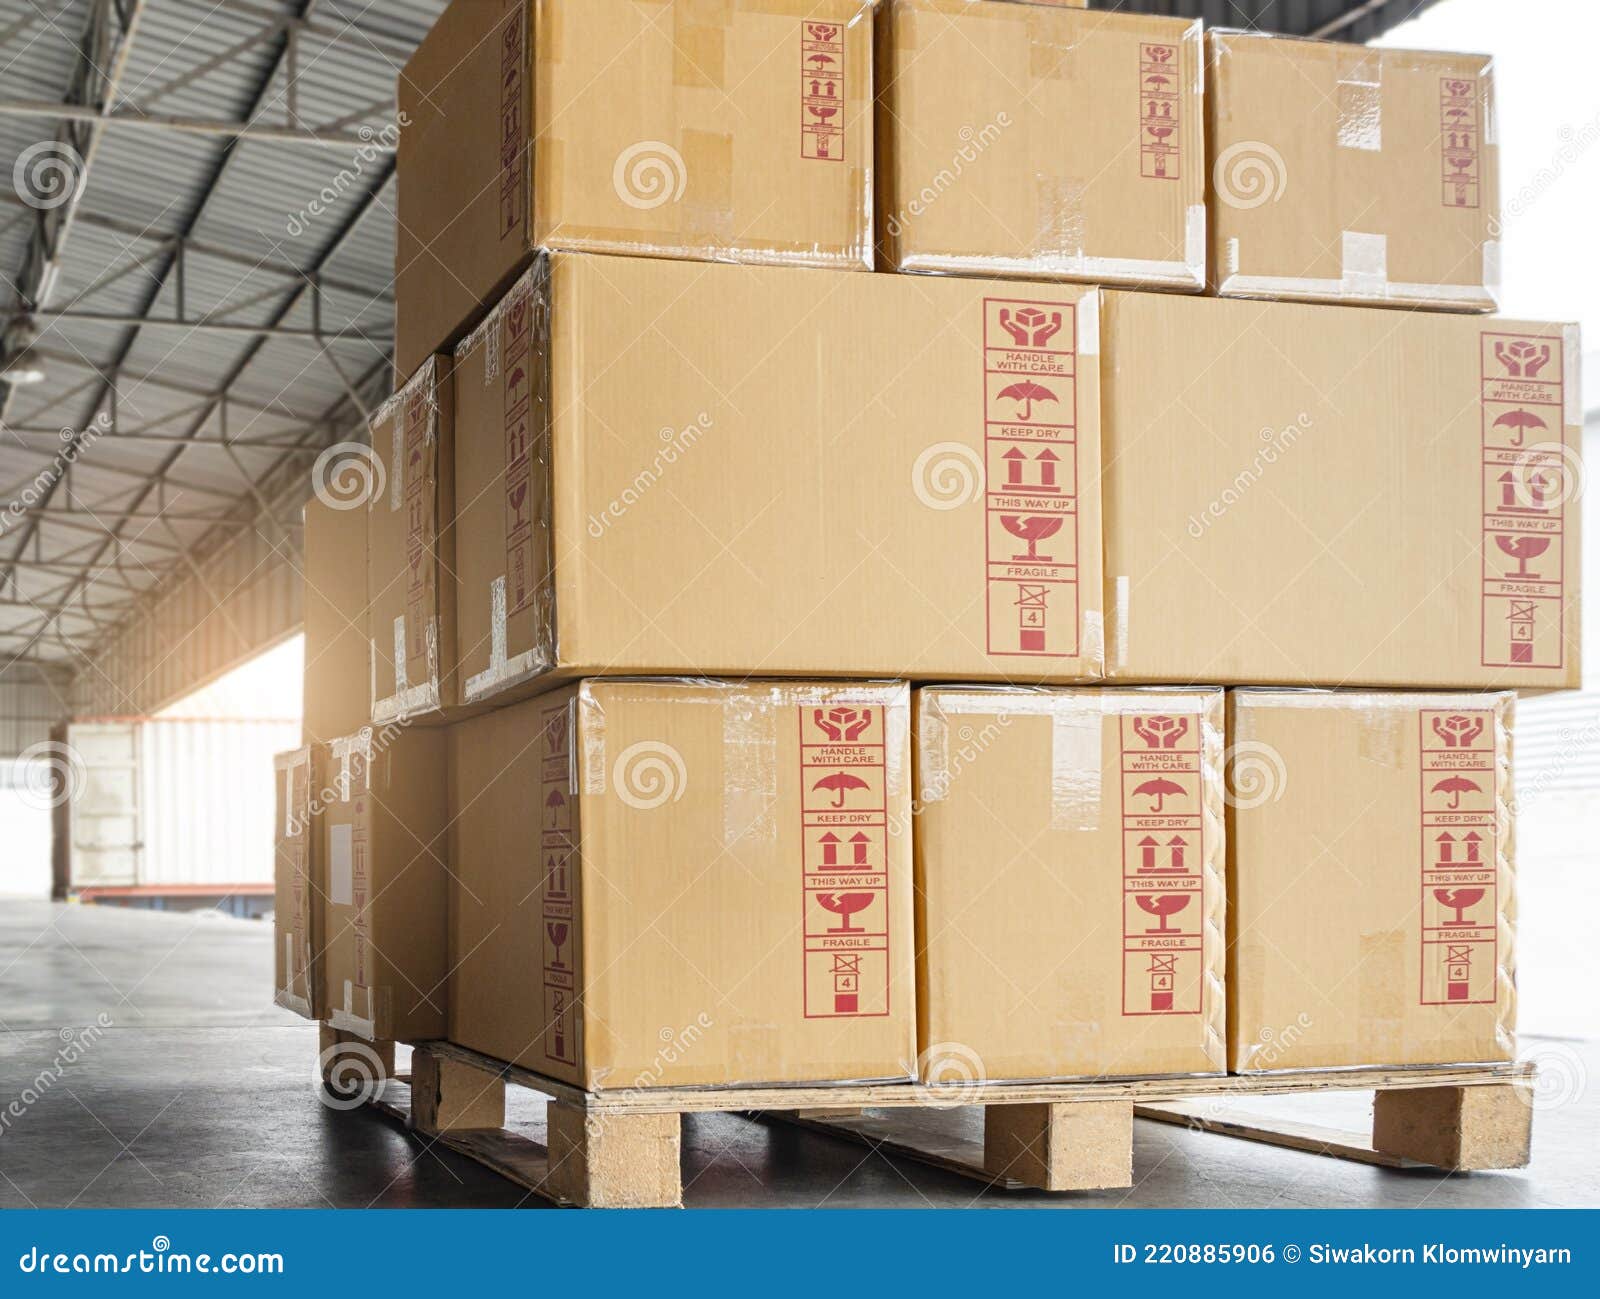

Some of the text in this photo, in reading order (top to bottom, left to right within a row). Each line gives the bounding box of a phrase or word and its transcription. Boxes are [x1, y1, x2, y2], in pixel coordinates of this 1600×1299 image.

[1006, 352, 1055, 364] HANDLE
[996, 361, 1064, 373] WITH CARE
[1501, 383, 1544, 393] HANDLE
[1492, 391, 1553, 401] WITH CARE
[1001, 427, 1061, 438] KEEP DRY
[994, 498, 1069, 509] THIS WAY UP
[1490, 518, 1556, 529] THIS WAY UP
[1007, 567, 1059, 578] FRAGILE
[1500, 584, 1545, 594] FRAGILE
[1027, 612, 1037, 624] 4
[1517, 626, 1526, 636] 4
[812, 755, 875, 763] WITH CARE
[1140, 754, 1183, 762] HANDLE
[1132, 762, 1192, 770] WITH CARE
[1430, 760, 1456, 768] WITH
[817, 814, 872, 823] KEEP DRY
[1136, 819, 1189, 827] KEEP DRY
[1434, 815, 1484, 823] KEEP DRY
[811, 877, 880, 886] THIS WAY UP
[1429, 874, 1450, 882] THIS
[1477, 873, 1490, 881] UP
[1131, 880, 1154, 888] THIS
[1438, 931, 1481, 939] FRAGILE
[823, 938, 871, 947] FRAGILE
[1141, 939, 1186, 947] FRAGILE
[1454, 967, 1463, 977] 4
[842, 978, 850, 988] 4
[1158, 976, 1166, 987] 4
